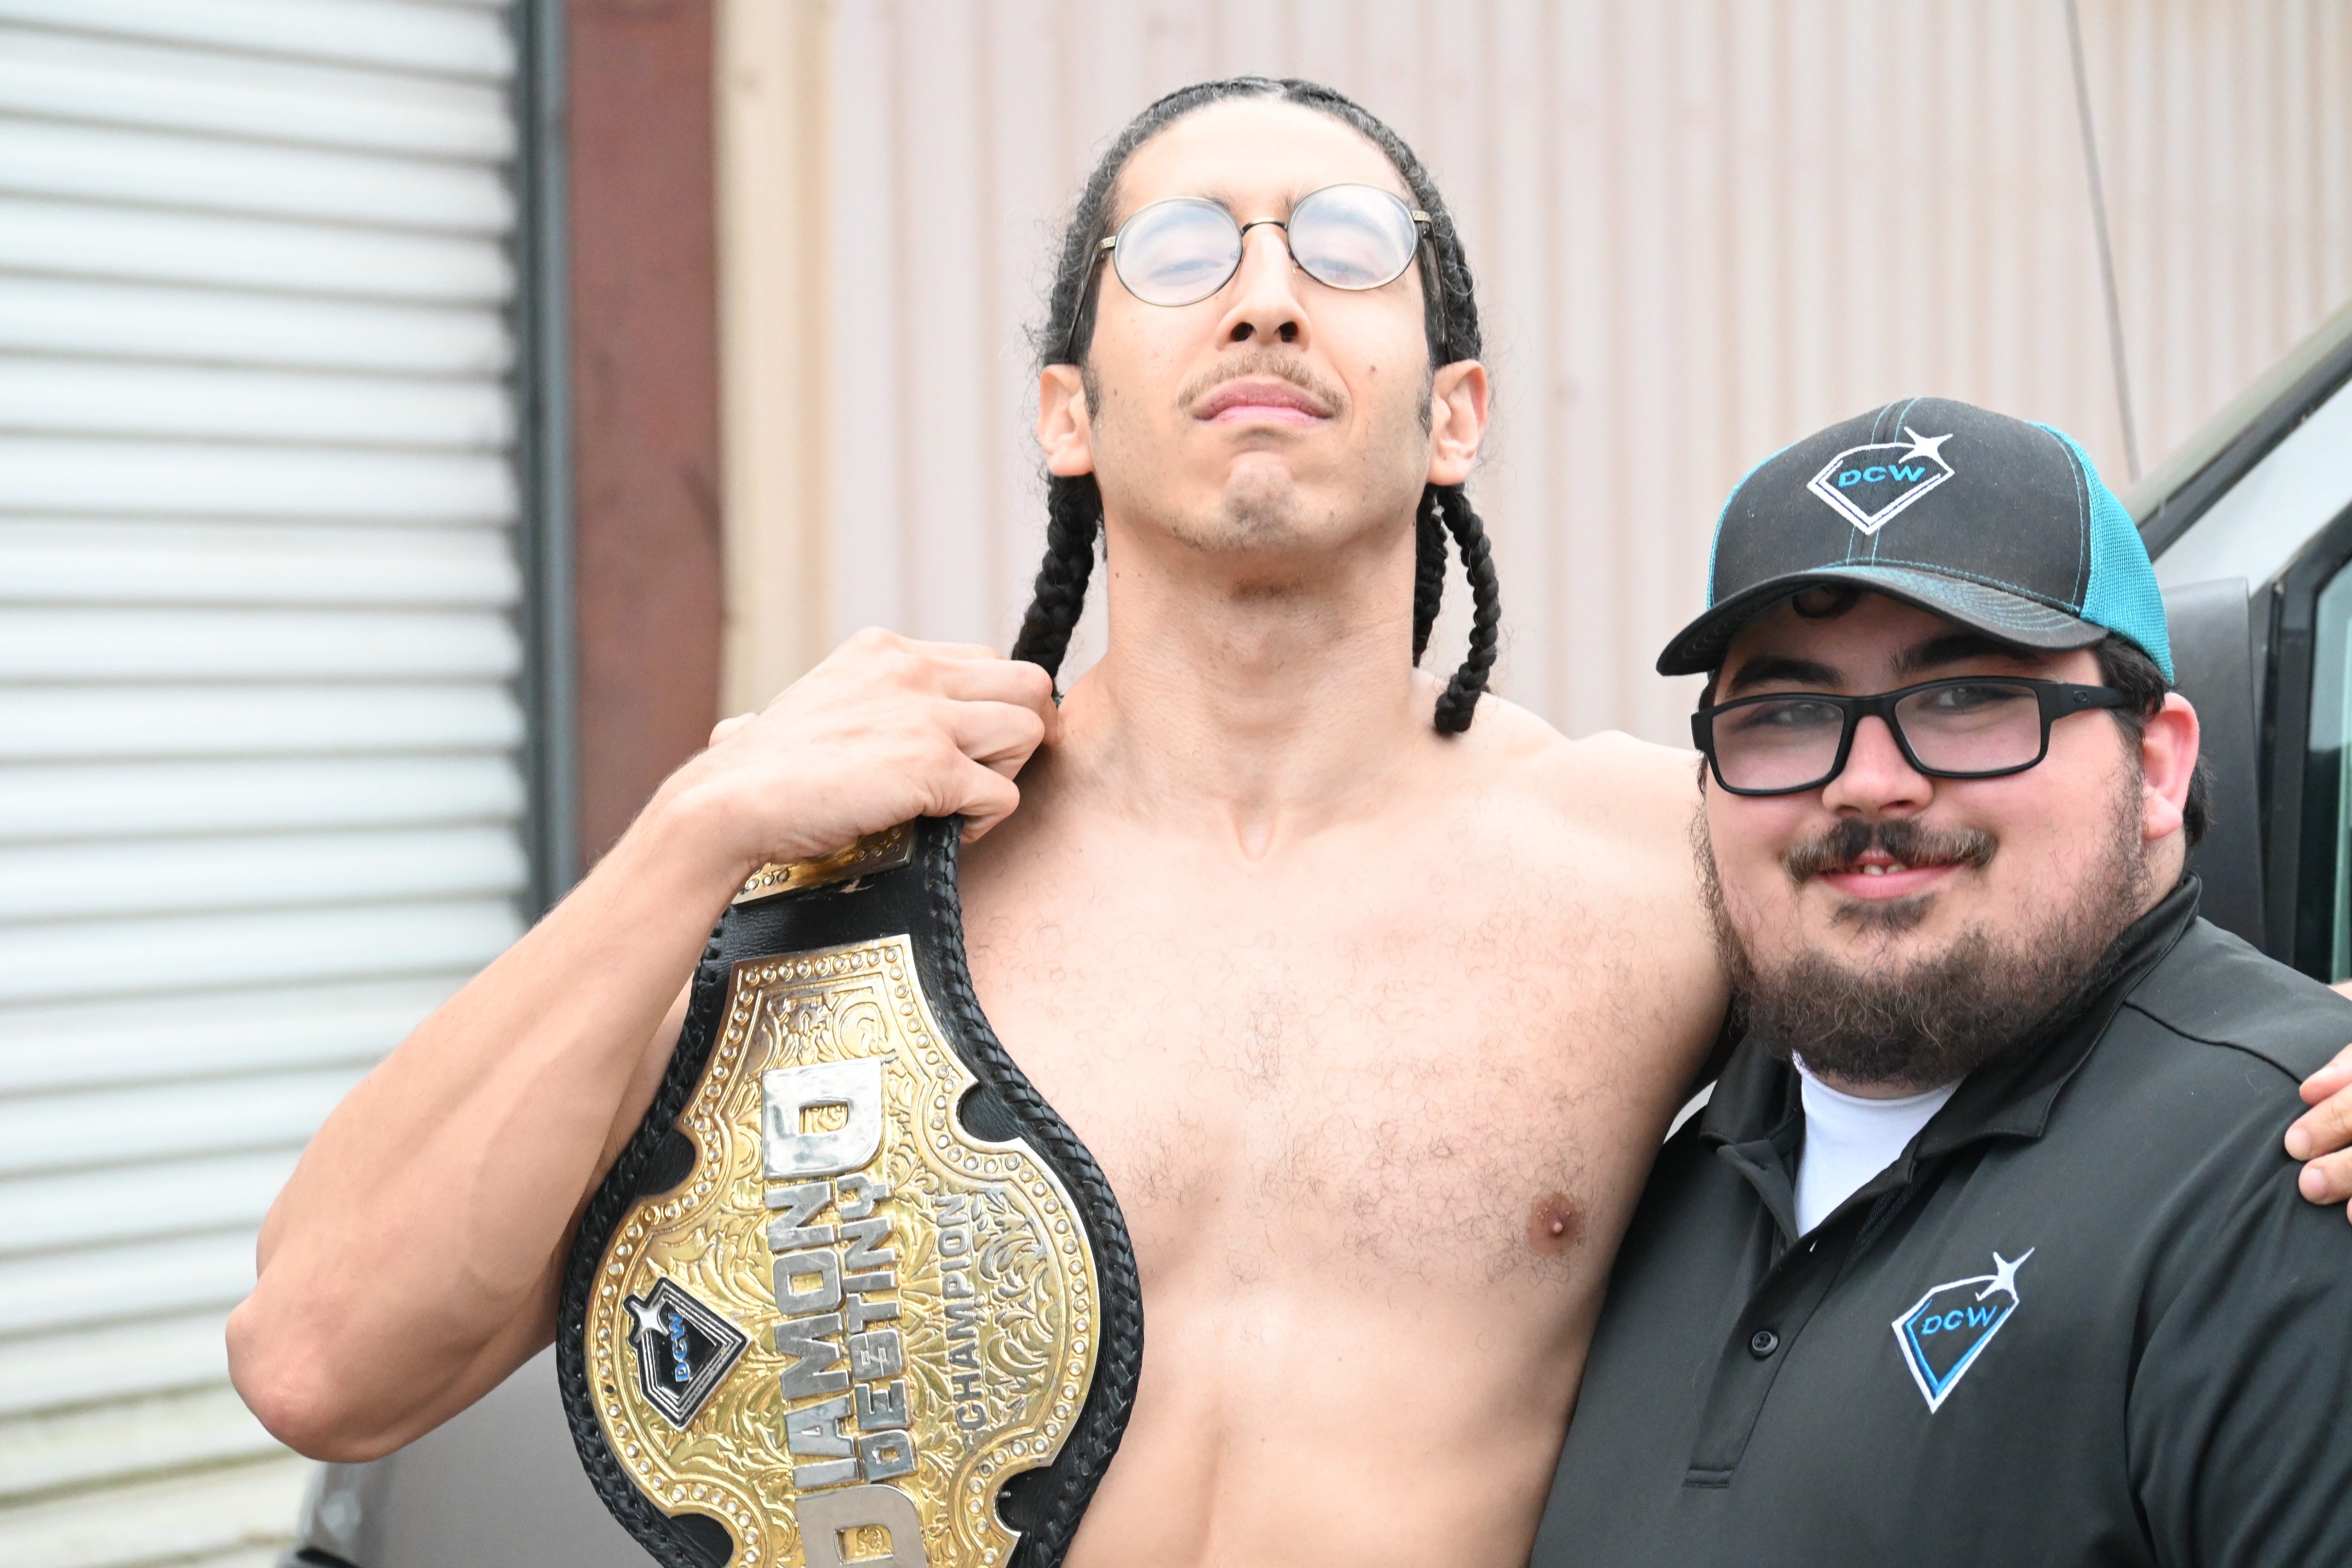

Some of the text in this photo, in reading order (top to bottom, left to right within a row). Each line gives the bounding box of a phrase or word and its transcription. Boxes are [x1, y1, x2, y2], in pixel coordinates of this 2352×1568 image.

[1838, 465, 1926, 488] DCW
[668, 1312, 691, 1383] DCW
[836, 1172, 917, 1482] DESTINY
[934, 1193, 987, 1431] CHAMPION
[1921, 1305, 1998, 1335] DCW
